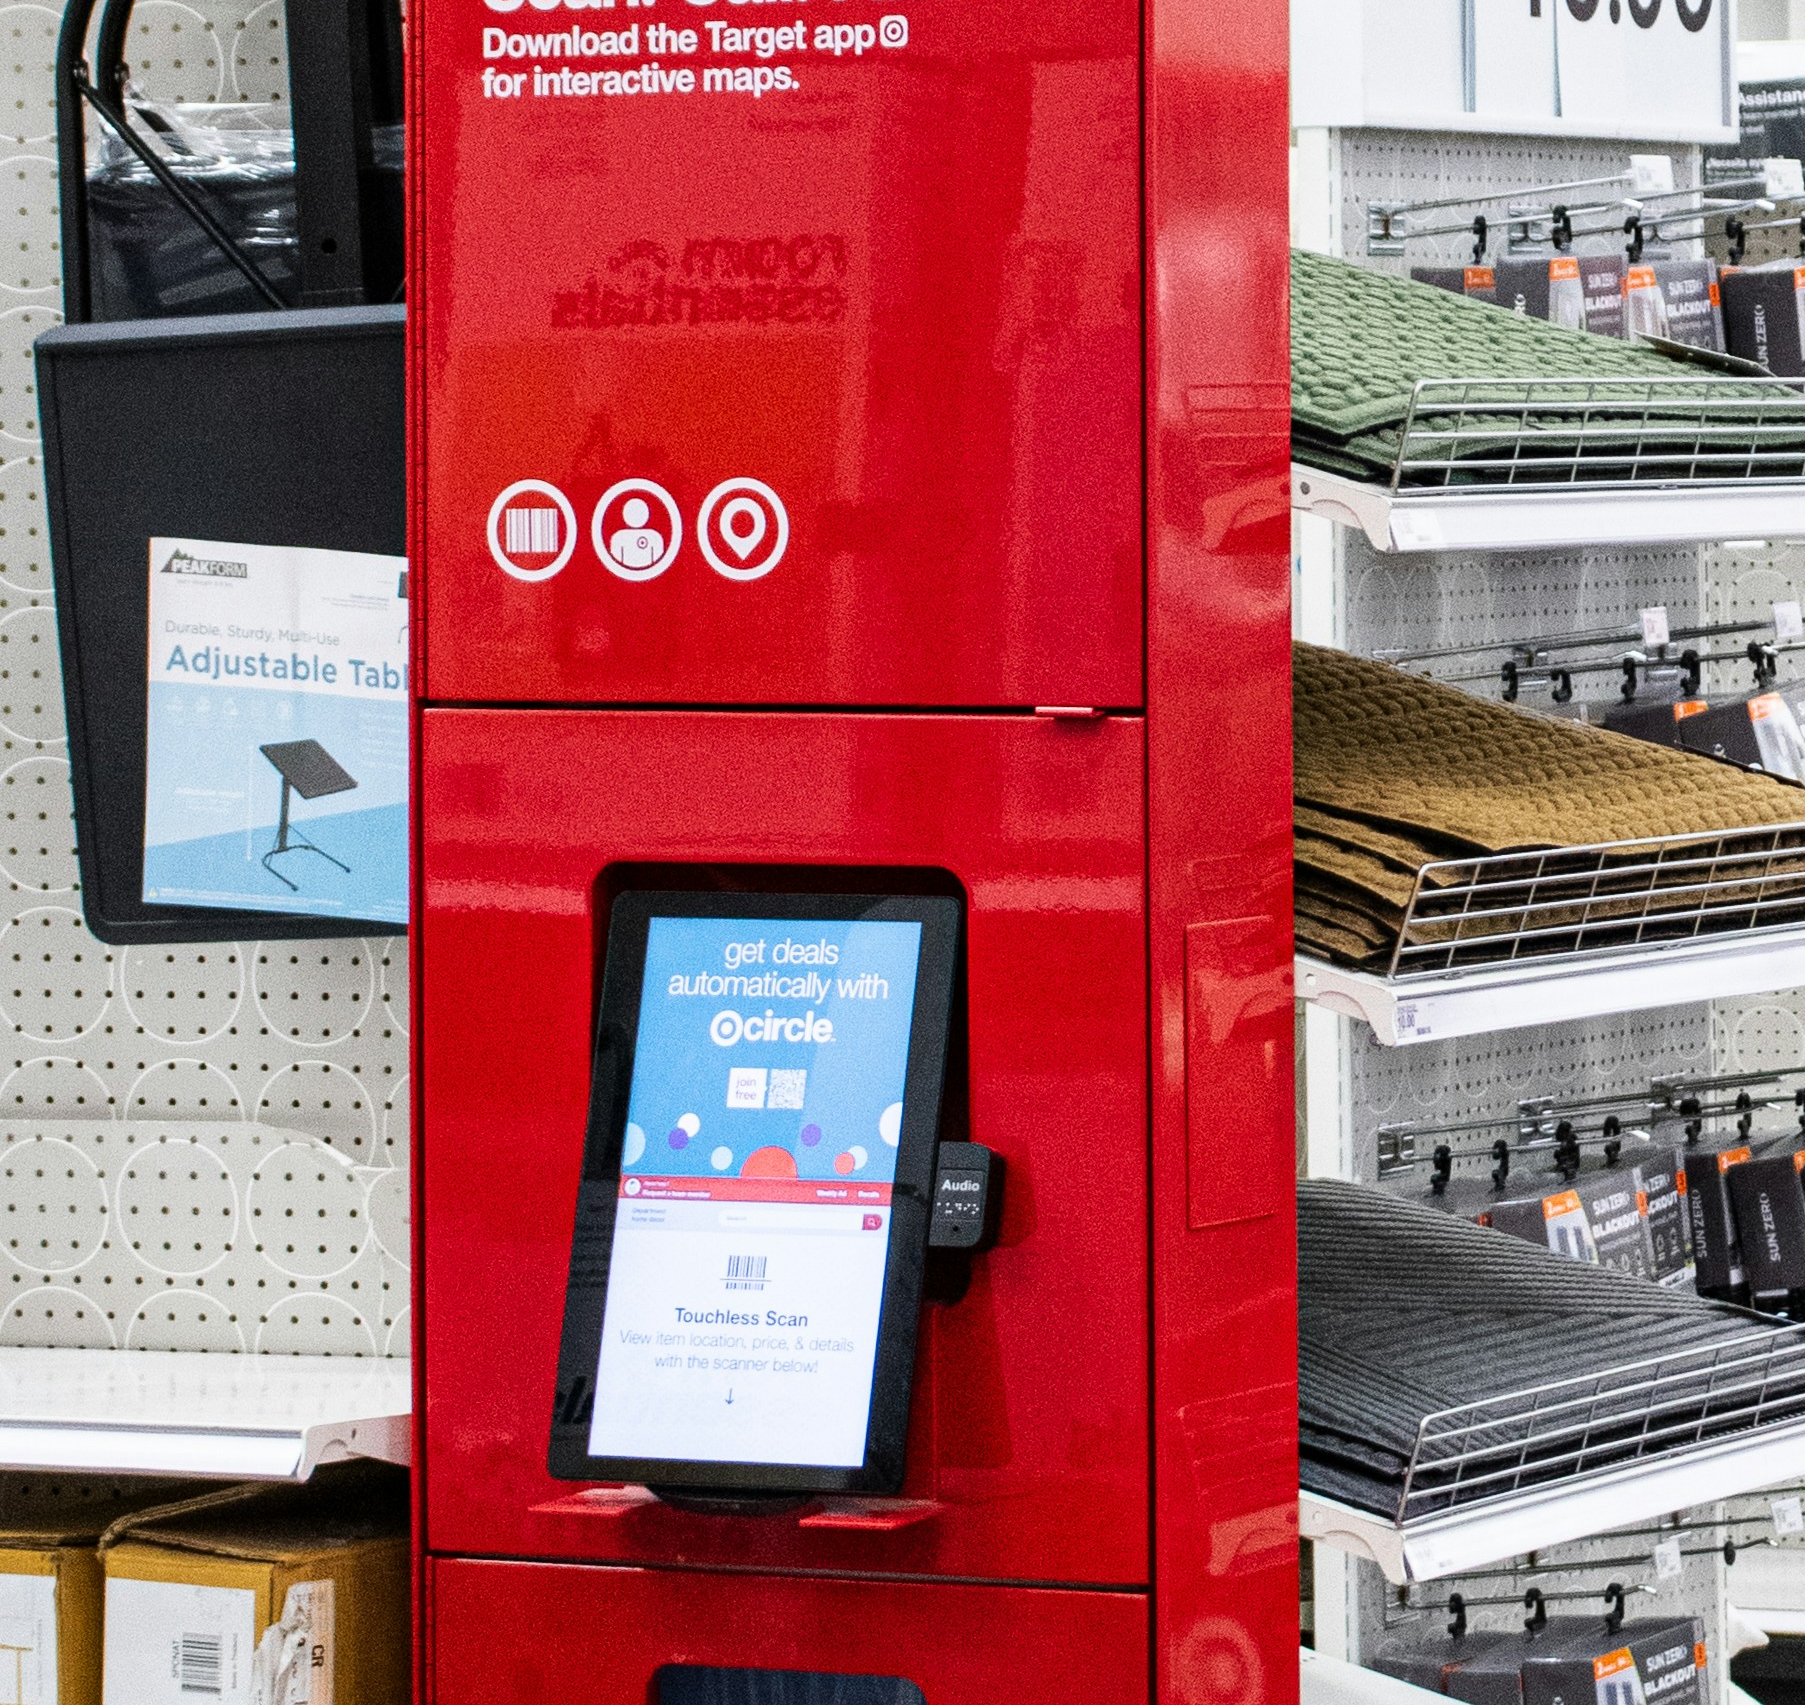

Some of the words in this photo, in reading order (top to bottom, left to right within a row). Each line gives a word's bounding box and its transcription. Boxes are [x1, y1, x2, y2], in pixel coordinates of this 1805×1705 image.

[483, 23, 639, 59] Download
[646, 24, 698, 54] the
[705, 18, 807, 59] Target
[813, 24, 876, 57] app
[481, 68, 527, 99] for
[534, 62, 697, 97] interactive
[703, 65, 800, 99] maps.
[166, 645, 338, 684] Adjustable
[724, 938, 766, 970] get
[772, 938, 839, 966] deals
[668, 971, 831, 1005] automatically
[837, 972, 889, 1000] with
[743, 1009, 836, 1044] circle
[941, 1179, 980, 1192] Audio
[1592, 1210, 1640, 1239] BLACKOUT
[1759, 1192, 1775, 1231] ZERO
[1766, 1233, 1781, 1262] SUN
[675, 1307, 759, 1326] Touchless
[765, 1310, 808, 1327] Scan
[620, 1330, 651, 1344] View
[656, 1331, 686, 1345] item
[690, 1332, 746, 1349] location,
[752, 1338, 789, 1352] price,
[794, 1337, 804, 1350] &
[809, 1337, 855, 1352] details
[655, 1355, 682, 1368] with
[687, 1355, 709, 1369] the
[712, 1356, 769, 1371] scanner
[773, 1357, 819, 1373] below!
[311, 1644, 325, 1668] CR
[1646, 1655, 1664, 1673] SUN
[1643, 1663, 1696, 1695] BLACKOUT
